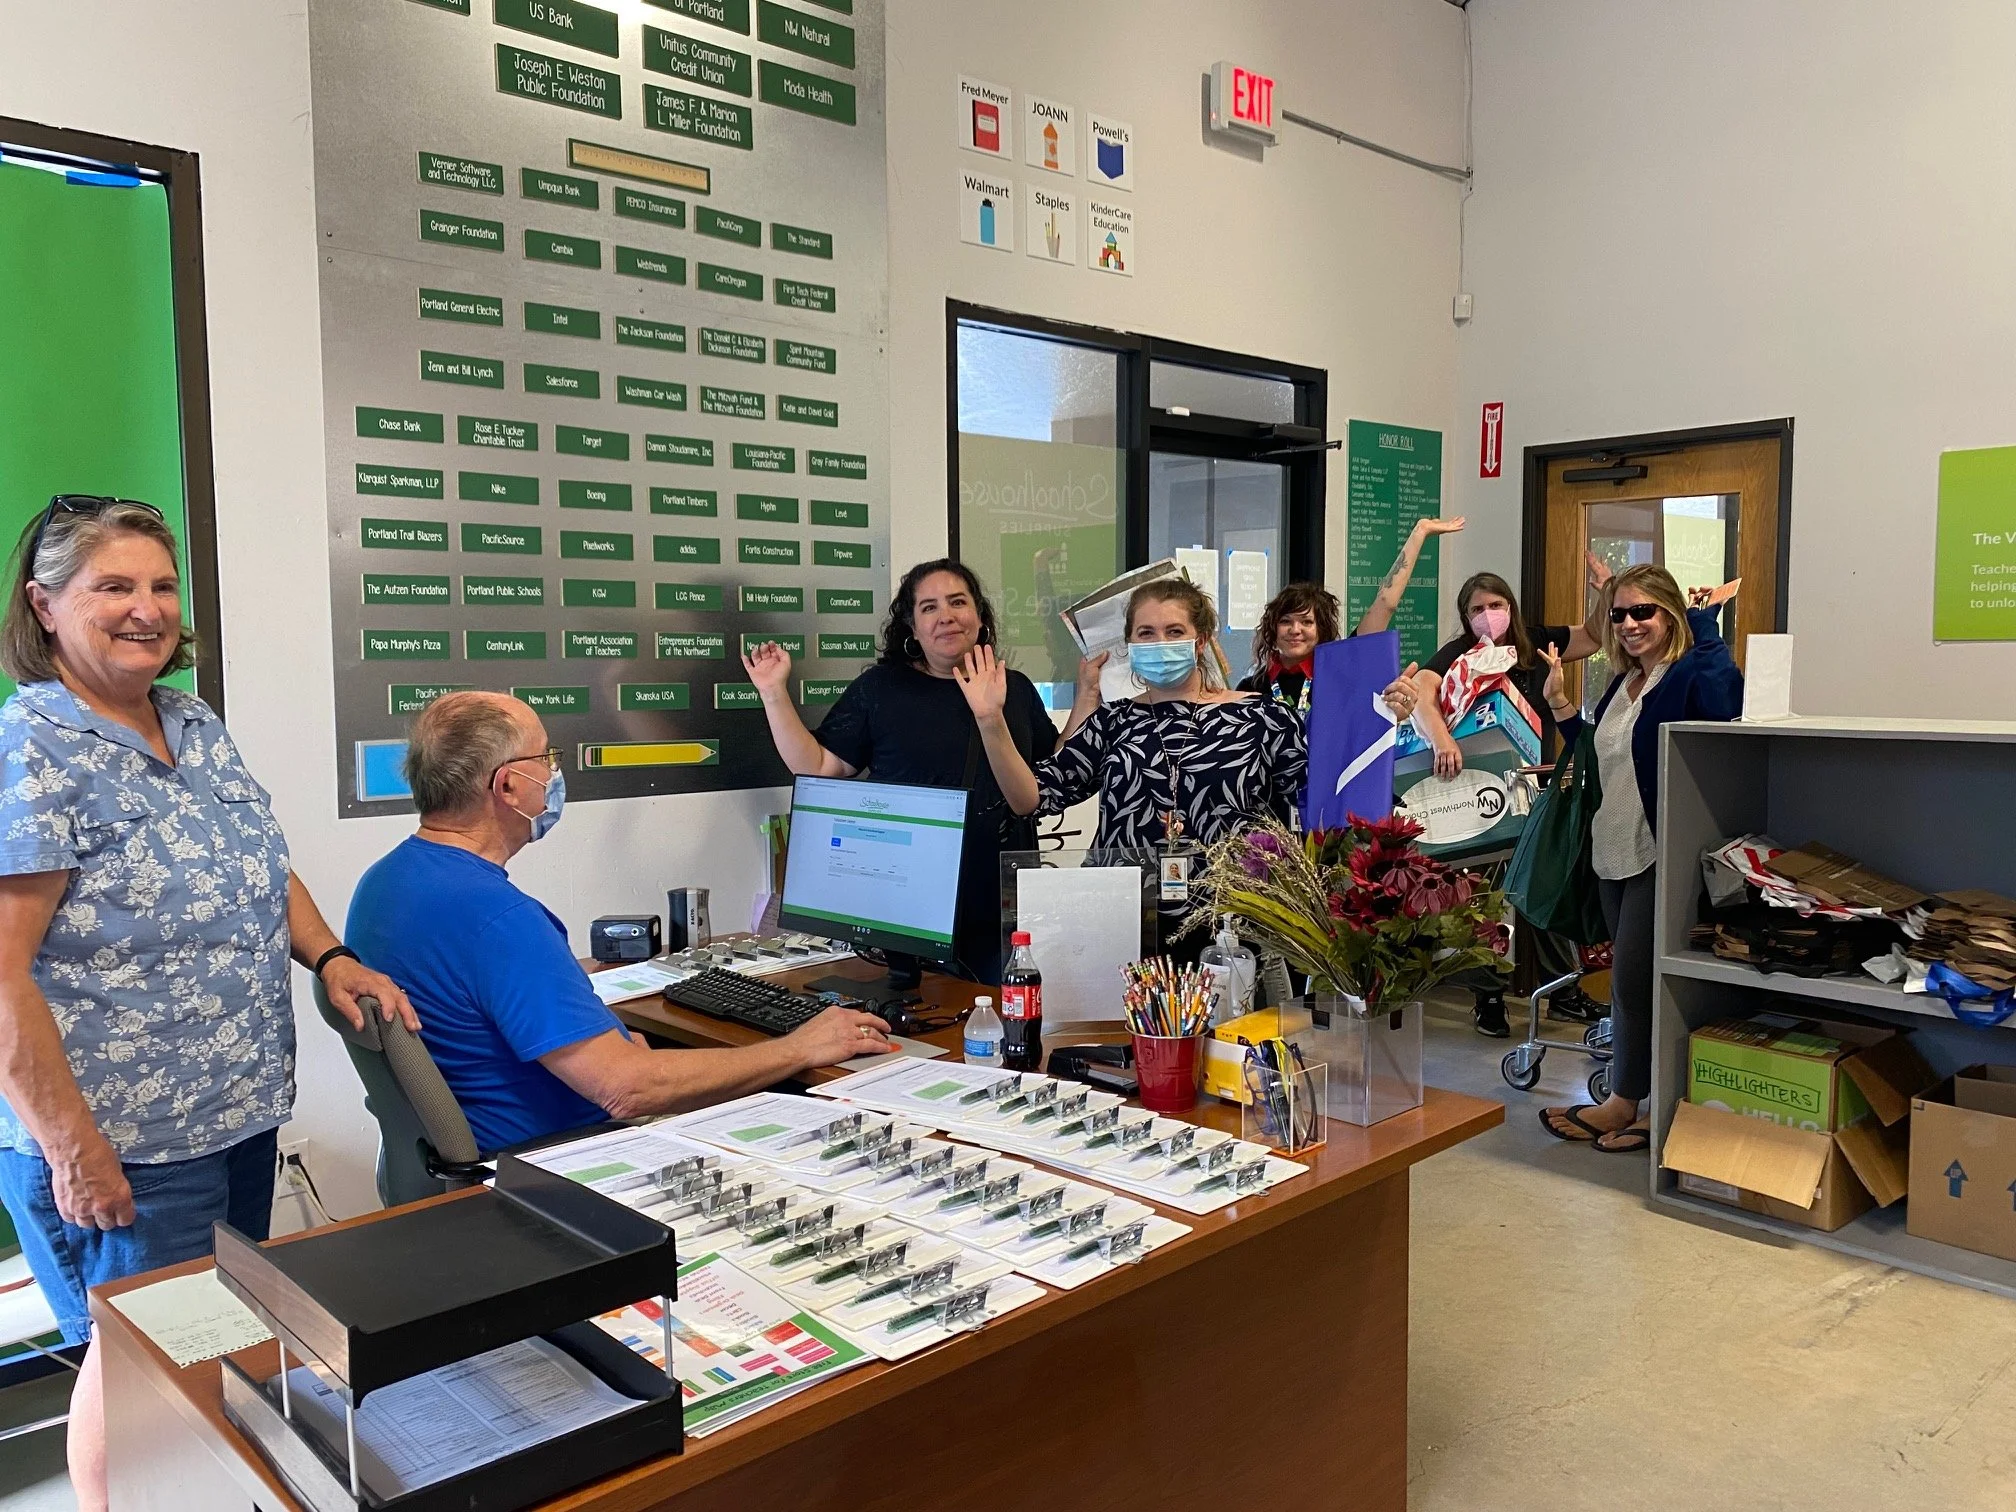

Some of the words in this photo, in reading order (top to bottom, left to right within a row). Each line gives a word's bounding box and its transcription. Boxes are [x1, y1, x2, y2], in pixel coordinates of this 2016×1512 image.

[529, 0, 544, 20] US
[548, 7, 573, 30] Bank
[784, 19, 798, 36] NW
[801, 24, 830, 46] Natural
[659, 33, 687, 55] Unitus
[690, 43, 736, 72] Community
[514, 52, 552, 79] Joseph
[568, 66, 606, 90] Weston
[670, 56, 698, 77] Credit
[701, 64, 724, 85] Union
[517, 73, 547, 96] Public
[551, 81, 605, 110] Foundation
[783, 78, 805, 98] Moda
[807, 85, 833, 105] Health
[961, 82, 980, 97] Fred
[982, 87, 1008, 105] Meyer
[1232, 68, 1274, 128] EXIT
[656, 90, 685, 111] James
[700, 100, 707, 116] &
[709, 102, 737, 123] Marion
[1032, 101, 1068, 123] JOANN
[668, 112, 691, 130] Miller
[694, 118, 741, 142] Foundation
[1092, 122, 1129, 143] Powell's
[430, 156, 457, 171] Vernier
[459, 161, 491, 177] Software
[427, 169, 440, 179] and
[442, 169, 479, 188] Technology
[481, 176, 496, 189] LLC
[537, 179, 562, 194] Umpqua
[564, 184, 580, 196] Bank
[964, 176, 1010, 199] Walmart
[1035, 192, 1070, 212] Staples
[1090, 202, 1132, 221] KinderCare
[430, 219, 459, 236] Grainger
[461, 224, 497, 240] Foundation
[1093, 217, 1129, 234] Education
[420, 297, 448, 311] Portland
[450, 301, 474, 314] General
[476, 303, 500, 317] Electric
[552, 312, 568, 325] Intel
[427, 360, 444, 372] Jenn
[446, 364, 459, 374] and
[461, 364, 471, 375] Bill
[473, 366, 493, 379] Lynch
[545, 374, 578, 388] Salesforce
[624, 385, 652, 398] Washman
[653, 389, 664, 400] Car
[665, 390, 681, 402] Wash
[1487, 412, 1498, 421] FIRE
[378, 418, 401, 430] Chase
[403, 419, 421, 432] Bank
[474, 421, 492, 433] Rose
[502, 424, 524, 436] Tucker
[472, 432, 506, 446] Charitable
[507, 436, 524, 448] Trust
[582, 434, 602, 448] Target
[1379, 433, 1398, 447] HONOR
[1400, 434, 1414, 449] ROLL
[358, 472, 387, 486] Klarquist
[389, 474, 424, 488] Sparkman,
[425, 477, 439, 488] LLP
[491, 483, 506, 494] Nike
[586, 488, 606, 502] Boeing
[662, 494, 686, 505] Portland
[686, 495, 708, 507] Timbers
[368, 527, 397, 540] Portland
[399, 529, 415, 540] Trail
[416, 530, 442, 542] Blazers
[481, 533, 525, 545] PacificSource
[1972, 533, 2002, 545] The
[679, 544, 697, 554] adidas
[745, 544, 761, 554] Fortis
[762, 545, 794, 556] Construction
[366, 583, 380, 594] The
[383, 584, 408, 595] Autzen
[411, 584, 448, 595] Foundation
[466, 584, 494, 596] Portland
[496, 585, 515, 596] Public
[517, 585, 542, 596] Schools
[592, 588, 606, 598] KGW
[1970, 580, 2016, 593] helping
[675, 591, 688, 601] LCG
[689, 591, 705, 601] Pence
[746, 592, 754, 602] Bill
[754, 593, 769, 604] Healy
[770, 593, 798, 603] Foundation
[1970, 599, 1984, 608] to
[370, 638, 388, 651] Papa
[390, 638, 420, 652] Murphy's
[423, 639, 441, 650] Pizza
[486, 640, 524, 652] CenturyLink
[572, 634, 597, 645] Portland
[599, 635, 633, 645] Association
[585, 645, 592, 656] of
[594, 645, 621, 656] Teachers
[528, 695, 543, 704] New
[545, 694, 560, 704] York
[562, 694, 574, 704] Life
[635, 691, 660, 701] Skanska
[661, 690, 674, 700] USA
[1430, 800, 1475, 816] NorthWest
[1696, 1062, 1812, 1107] HIGHLIGHTERS
